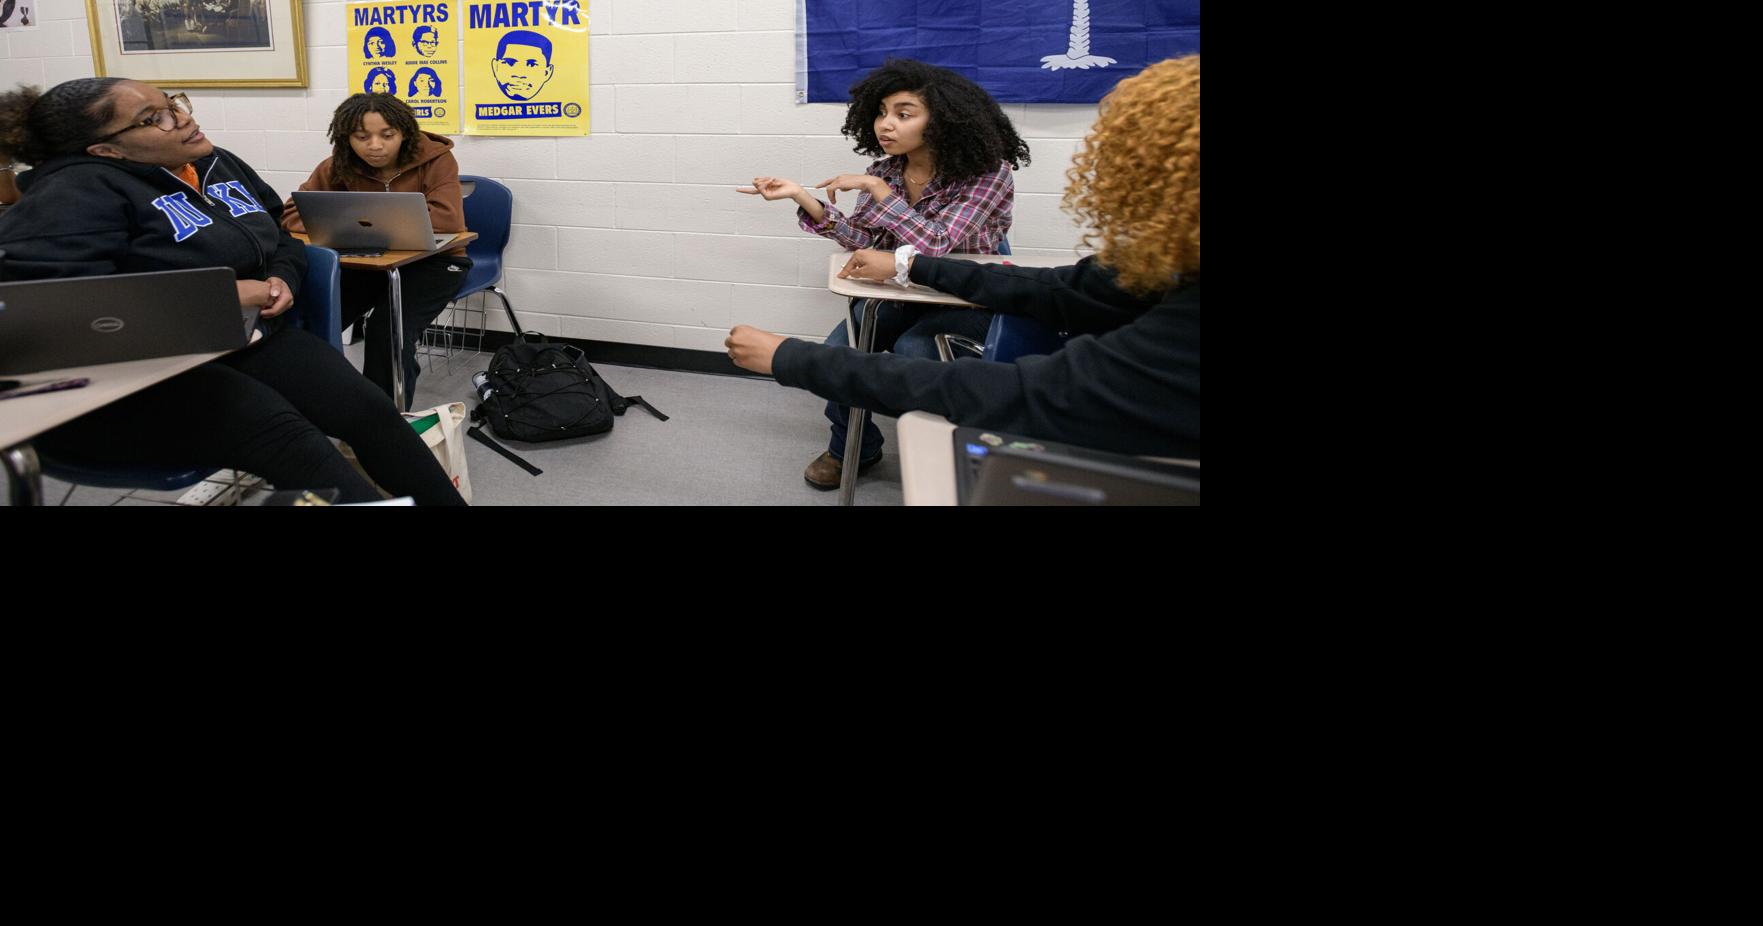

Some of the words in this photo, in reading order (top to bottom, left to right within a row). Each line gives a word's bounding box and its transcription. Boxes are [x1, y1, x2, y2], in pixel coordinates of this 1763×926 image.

[354, 3, 449, 26] MARTYRS
[469, 0, 581, 28] MARTYR
[478, 106, 522, 116] MEDGAR
[526, 104, 559, 115] EVERS
